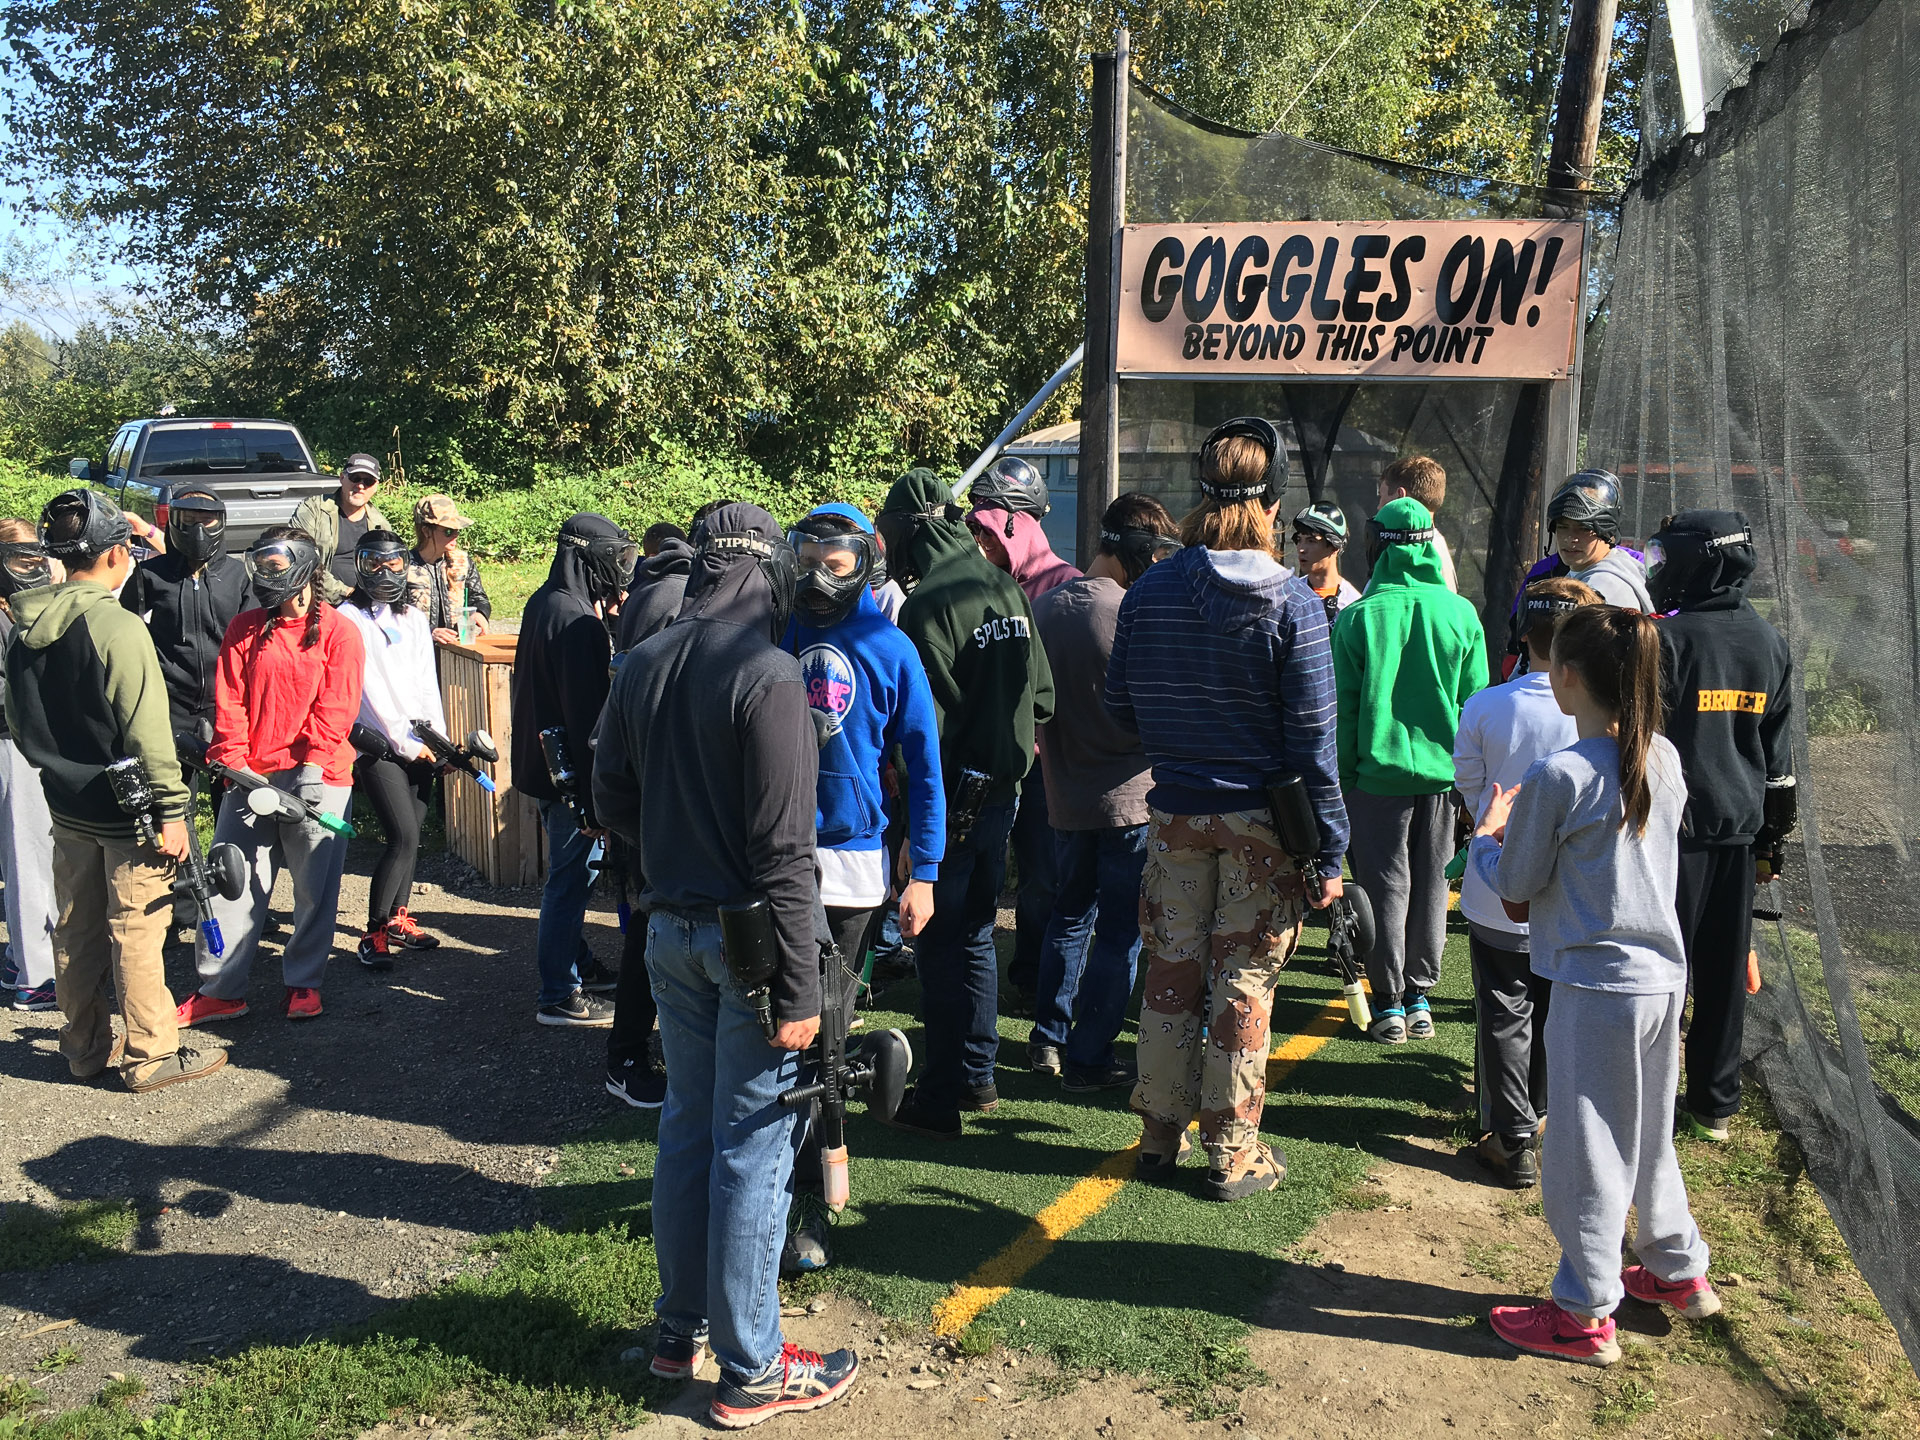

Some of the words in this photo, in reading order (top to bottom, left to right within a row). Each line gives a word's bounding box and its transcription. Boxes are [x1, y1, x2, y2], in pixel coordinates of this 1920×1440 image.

[1140, 235, 1427, 323] GOGGLES
[1434, 235, 1564, 328] ON!
[1181, 323, 1306, 361] BEYOND
[1315, 323, 1386, 362] THIS
[1390, 325, 1495, 365] POINT
[810, 677, 851, 697] CAMP
